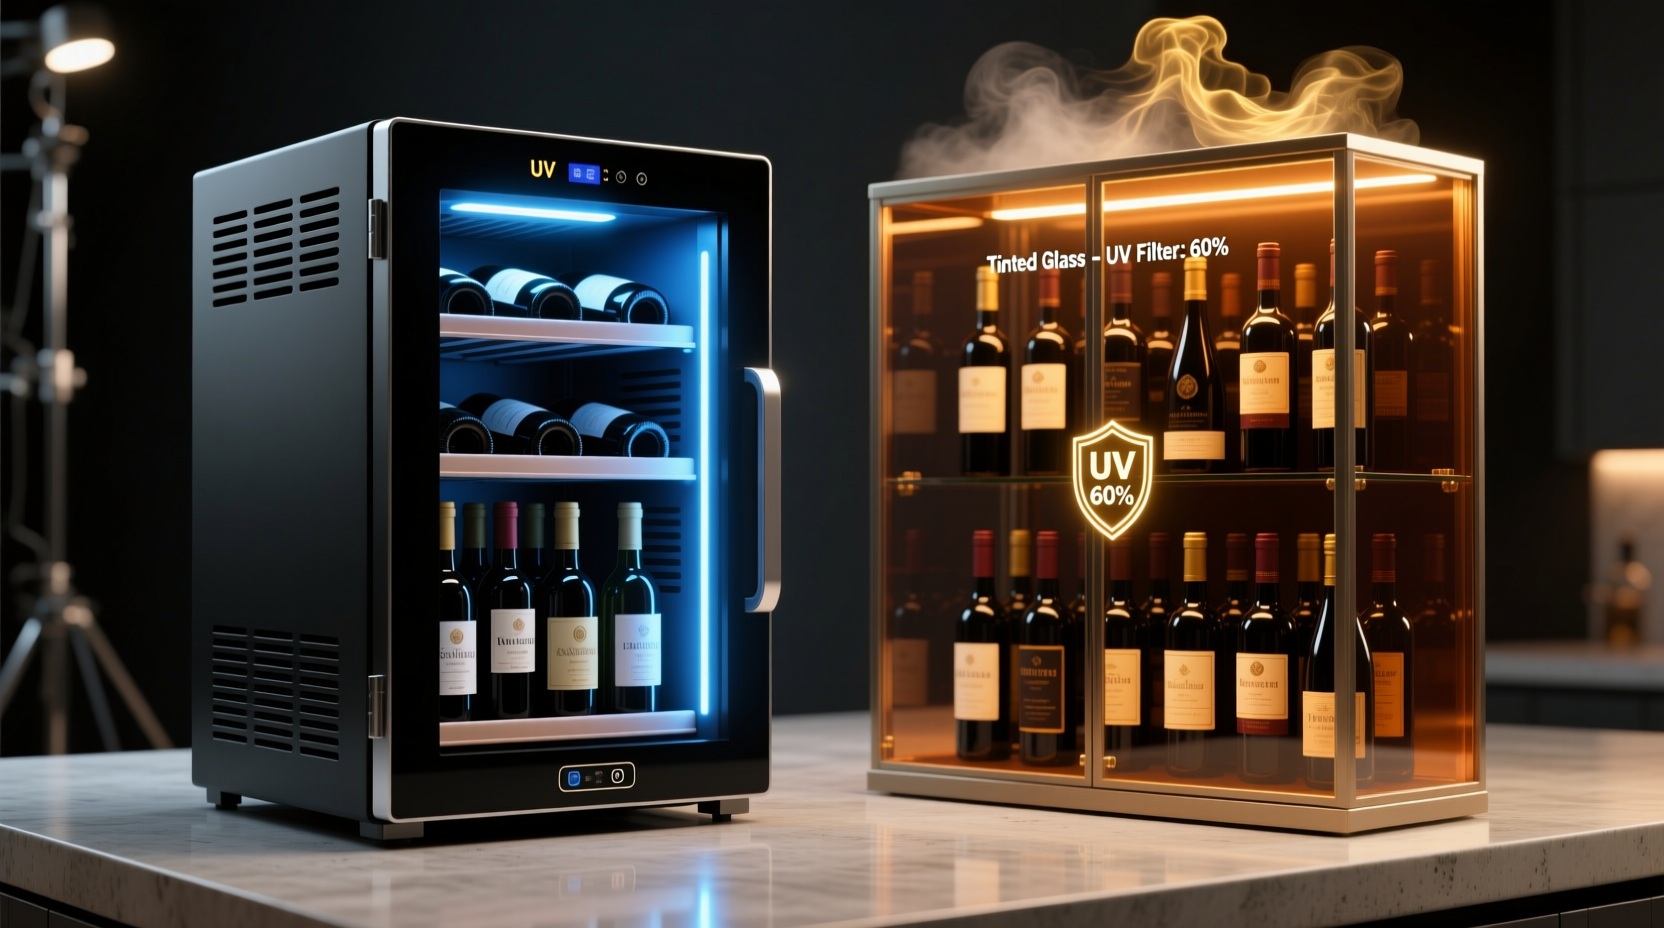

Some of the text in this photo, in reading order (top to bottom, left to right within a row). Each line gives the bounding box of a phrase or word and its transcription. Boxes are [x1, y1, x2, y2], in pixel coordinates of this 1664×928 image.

[530, 159, 556, 179] UV
[986, 252, 1037, 274] Tinted
[1041, 249, 1086, 270] Glass
[1106, 244, 1132, 265] UV
[1136, 241, 1186, 263] Filter:
[1189, 236, 1230, 258] 60%
[1090, 450, 1136, 480] UV
[1089, 484, 1135, 506] 60%
